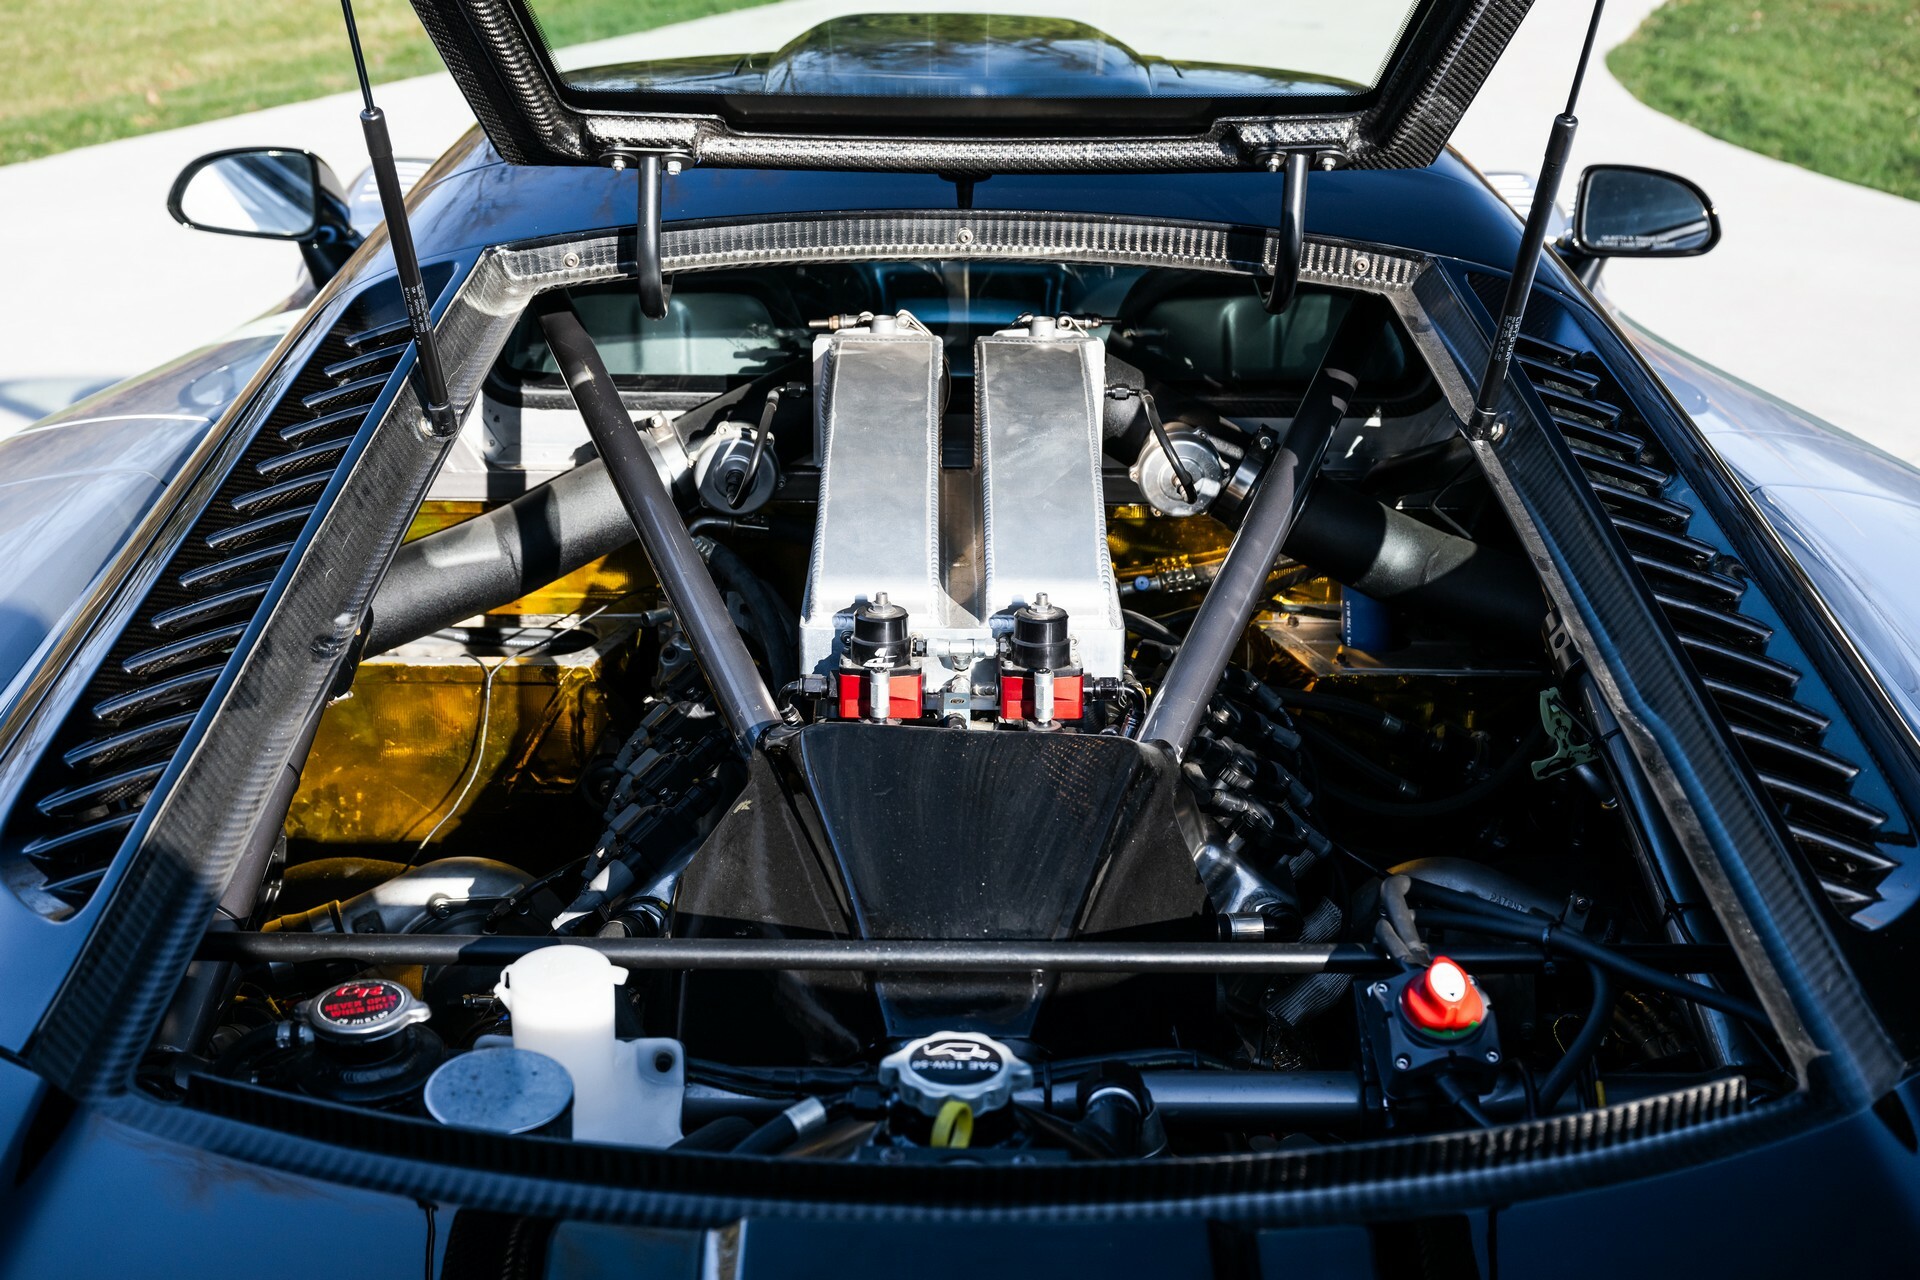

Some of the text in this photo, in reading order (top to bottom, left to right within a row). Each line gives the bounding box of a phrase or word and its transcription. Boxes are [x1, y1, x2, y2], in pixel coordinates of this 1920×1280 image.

[325, 994, 398, 1013] NEVER OPEN
[330, 1006, 365, 1018] WHEN
[968, 1060, 1000, 1072] SAE
